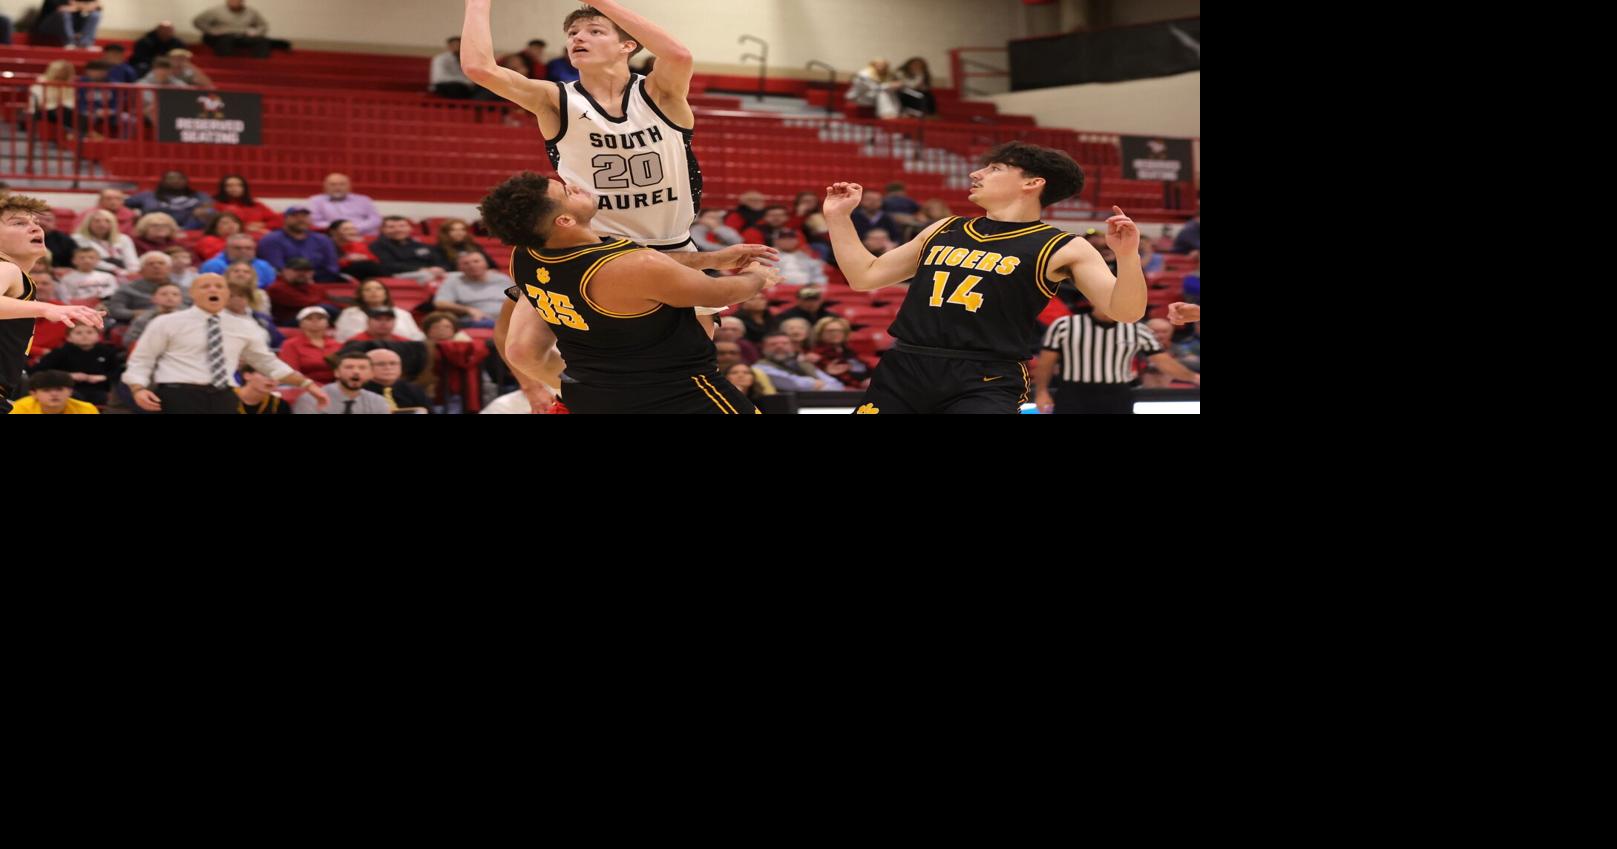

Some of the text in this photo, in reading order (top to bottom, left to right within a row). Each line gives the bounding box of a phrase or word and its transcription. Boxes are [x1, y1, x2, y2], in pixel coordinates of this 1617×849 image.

[175, 118, 245, 132] RESERVED
[180, 130, 240, 144] SEATING
[589, 125, 663, 149] SOUTH
[591, 151, 664, 189] 20
[597, 187, 679, 210] AUREL
[923, 245, 1021, 275] TIGERS
[928, 270, 984, 313] 14
[525, 283, 590, 331] 35
